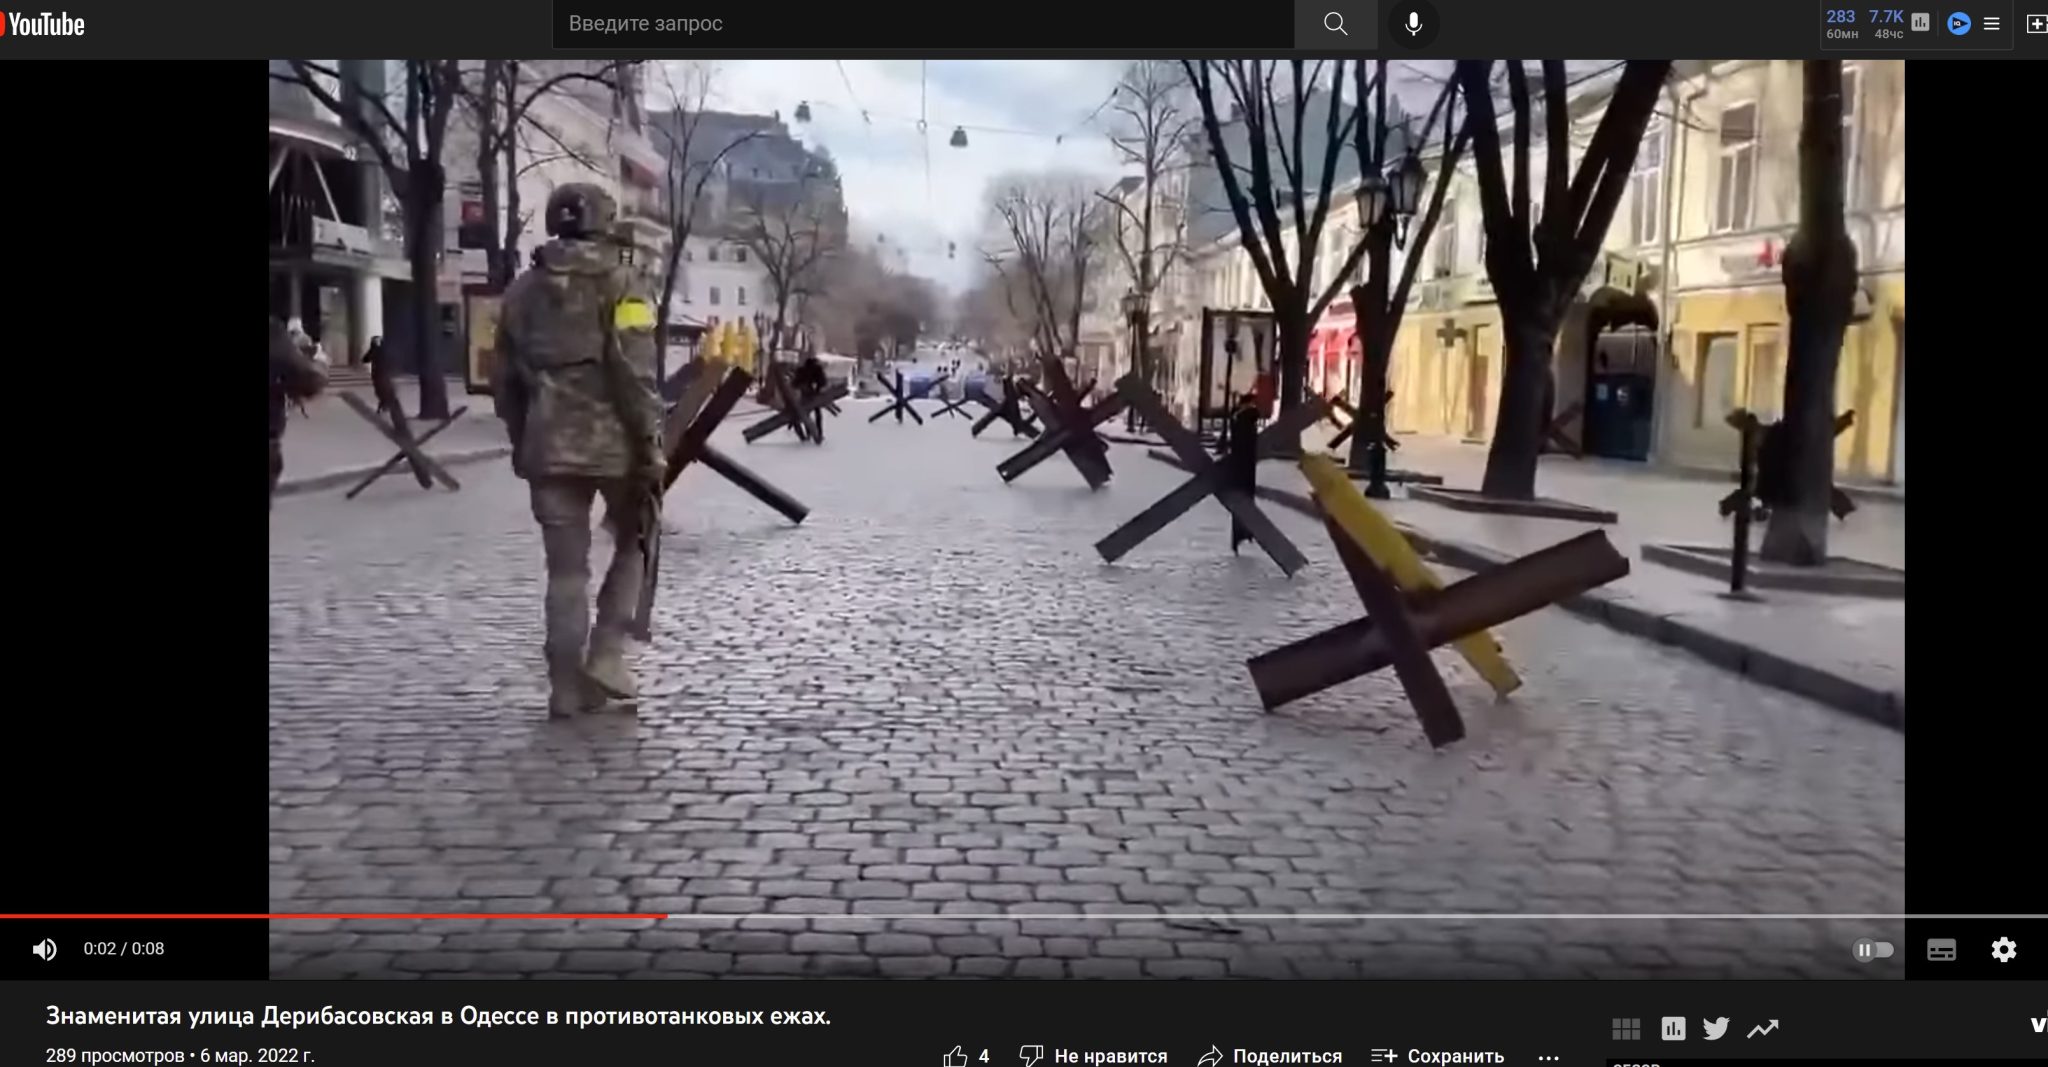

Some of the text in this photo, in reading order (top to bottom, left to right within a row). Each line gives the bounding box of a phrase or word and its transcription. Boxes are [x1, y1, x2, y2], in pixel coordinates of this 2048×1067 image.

[9, 11, 85, 36] YouTube
[569, 14, 722, 36] Введите запрос
[1826, 9, 1905, 24] 283 7.7K
[1826, 28, 1904, 39] 60мн 48чс
[83, 941, 165, 957] 0:02 / 0:08
[45, 1004, 831, 1030] Знаменитая улица Дерибасовская в Одессе в противотанковых ежах.
[45, 1047, 315, 1067] 289 просмотров 6 мар. 2022 г.
[978, 1048, 990, 1064] 4
[1055, 1048, 1168, 1067] Не нравится
[1233, 1048, 1343, 1067] Поделиться
[1408, 1048, 1505, 1067] Сохранить
